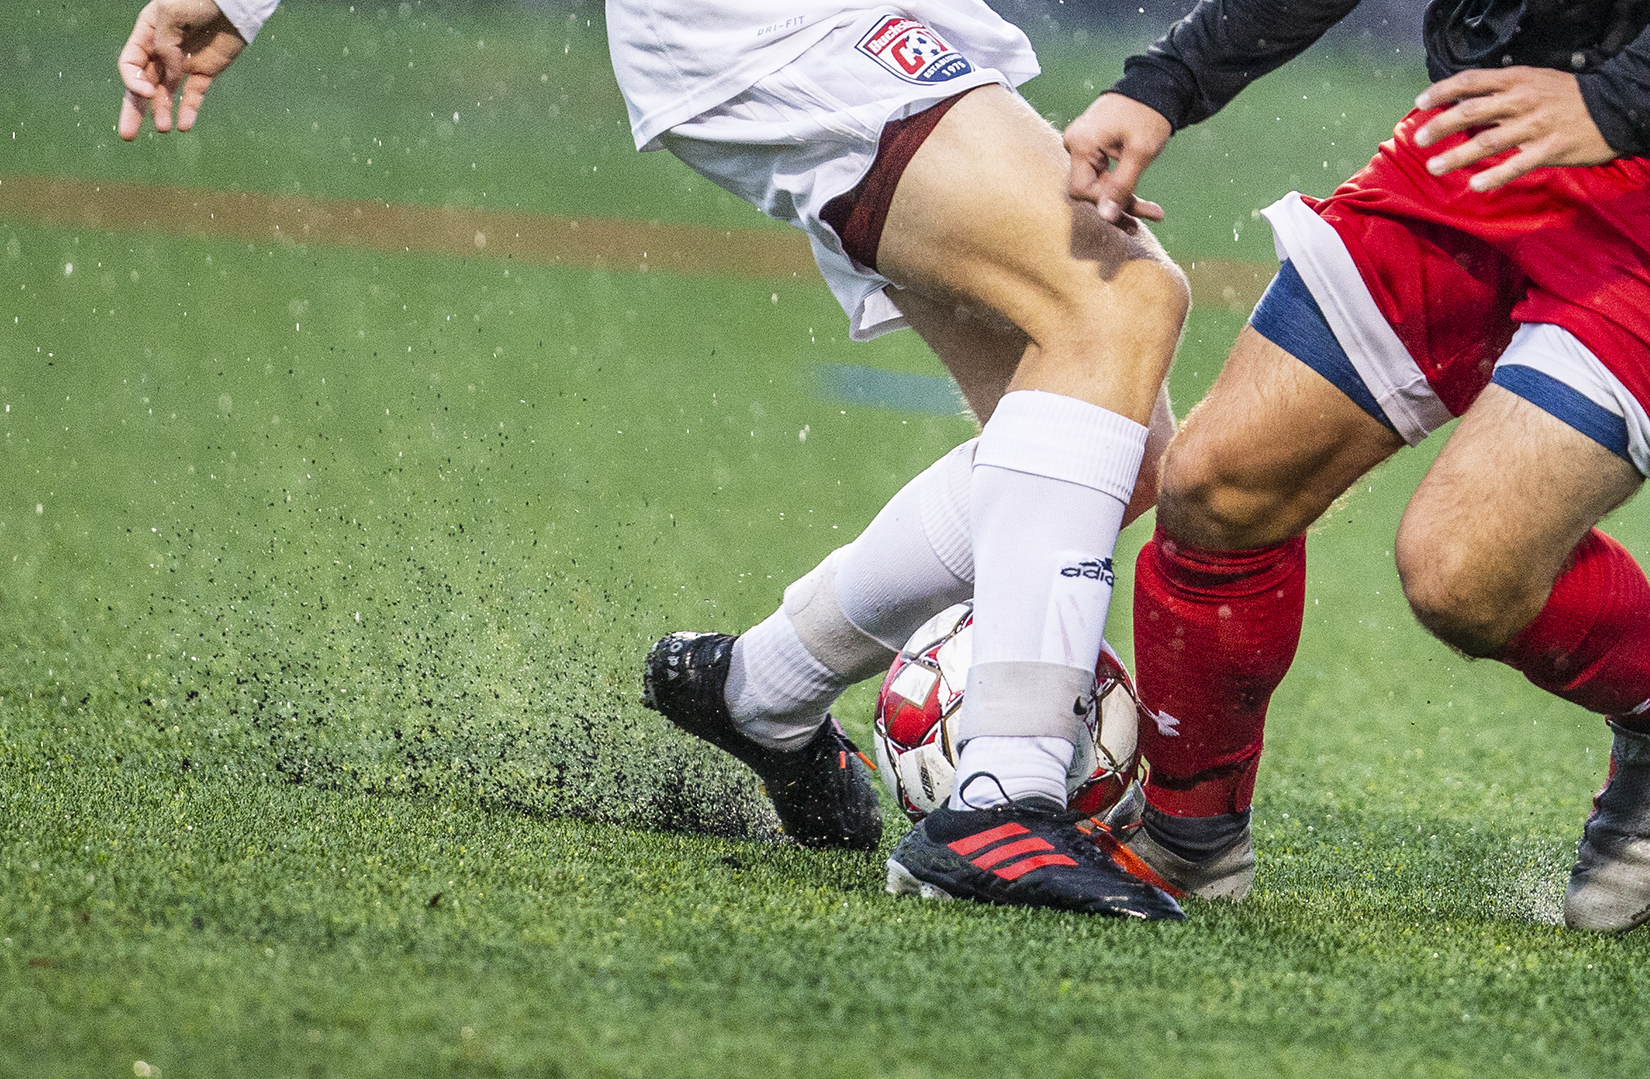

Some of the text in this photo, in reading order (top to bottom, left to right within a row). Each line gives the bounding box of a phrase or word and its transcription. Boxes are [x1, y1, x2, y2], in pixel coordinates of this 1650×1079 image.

[756, 14, 806, 37] DRI-FIT
[940, 60, 967, 78] 1975
[1060, 565, 1116, 589] adid
